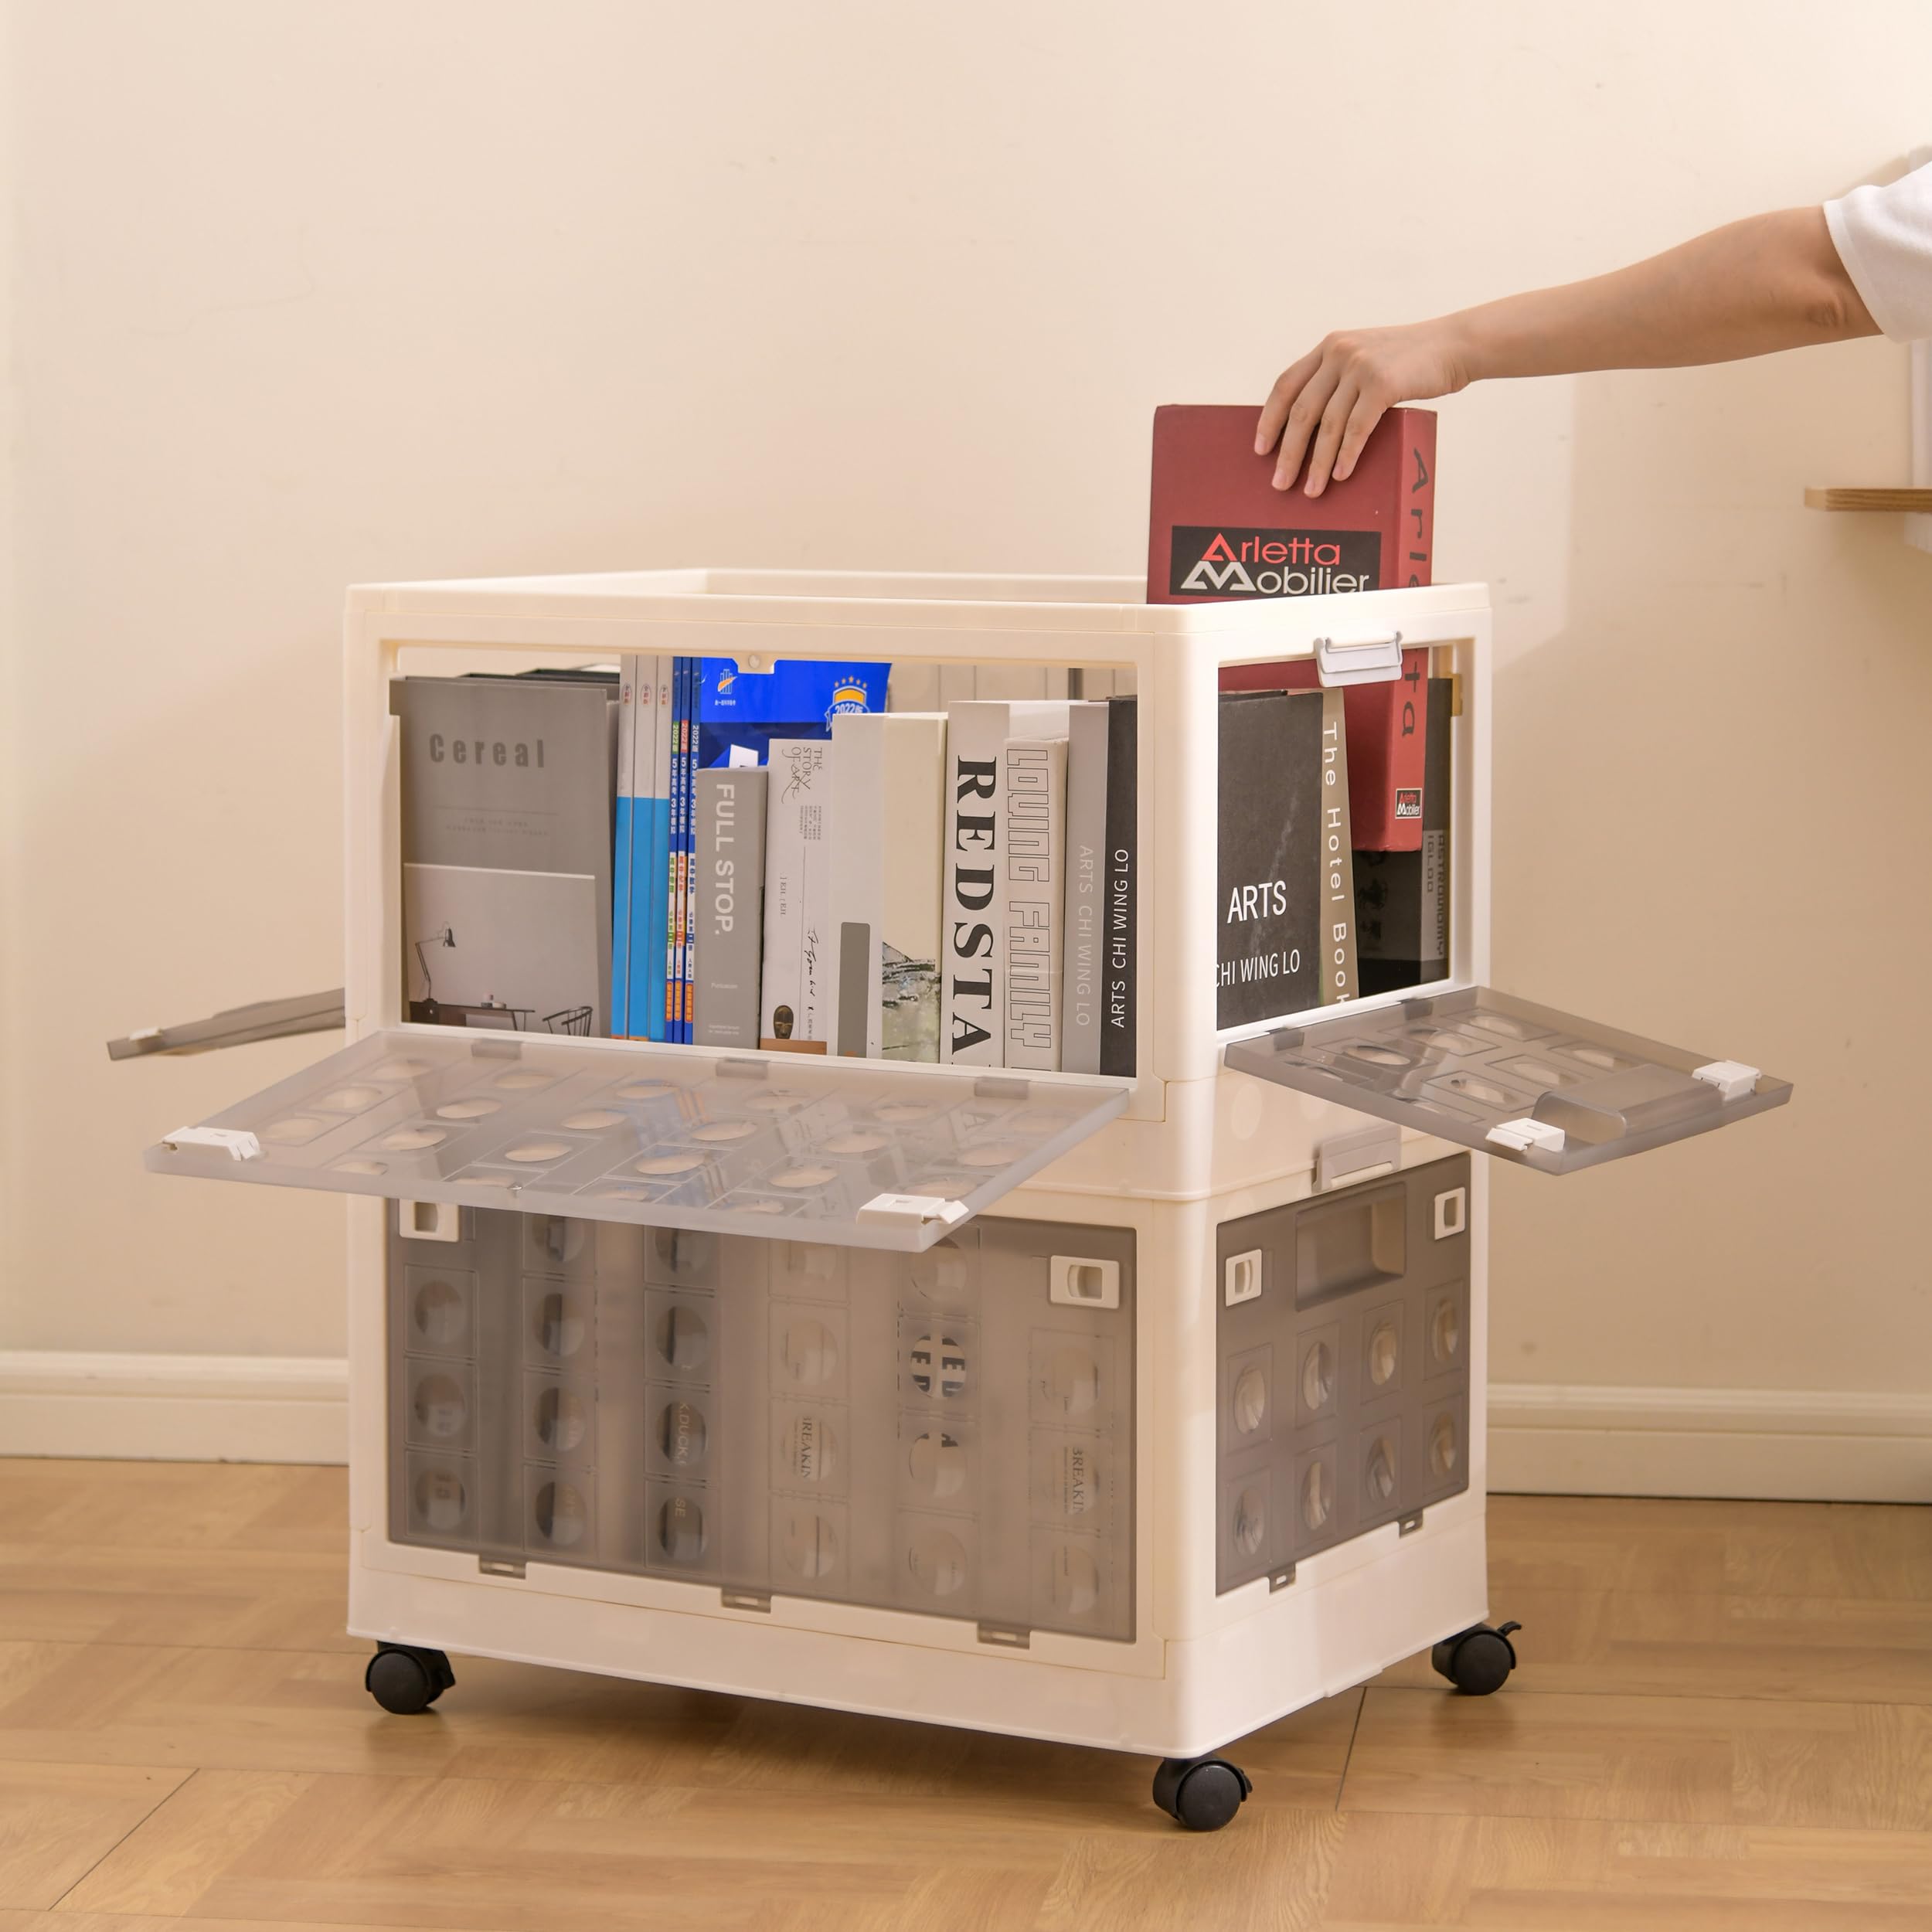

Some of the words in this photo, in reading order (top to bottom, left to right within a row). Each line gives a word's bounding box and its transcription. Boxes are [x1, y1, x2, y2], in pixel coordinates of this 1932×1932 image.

[1200, 532, 1342, 566] Arletta
[1180, 560, 1371, 595] Mobilier
[1402, 447, 1429, 737] Arlta
[429, 733, 545, 768] Cereal
[782, 747, 802, 762] OF
[799, 747, 811, 793] STORY
[813, 747, 823, 771] THE
[1324, 721, 1338, 787] The
[716, 784, 735, 852] FULL
[1079, 845, 1094, 893] ARTS
[1114, 849, 1129, 872] LO
[1327, 807, 1345, 903] Hotel
[713, 860, 734, 935] STOP.
[951, 753, 997, 1067] REDSTA
[1113, 879, 1128, 930] WING
[1226, 879, 1287, 924] ARTS
[1078, 905, 1092, 937] CHI
[1009, 900, 1052, 1049] FAMILY
[1077, 944, 1092, 995] WING
[1112, 937, 1127, 969] CHI
[1240, 952, 1279, 983] WING
[1282, 947, 1301, 975] LO
[1076, 1002, 1090, 1026] LO
[1111, 981, 1126, 1029] ARTS
